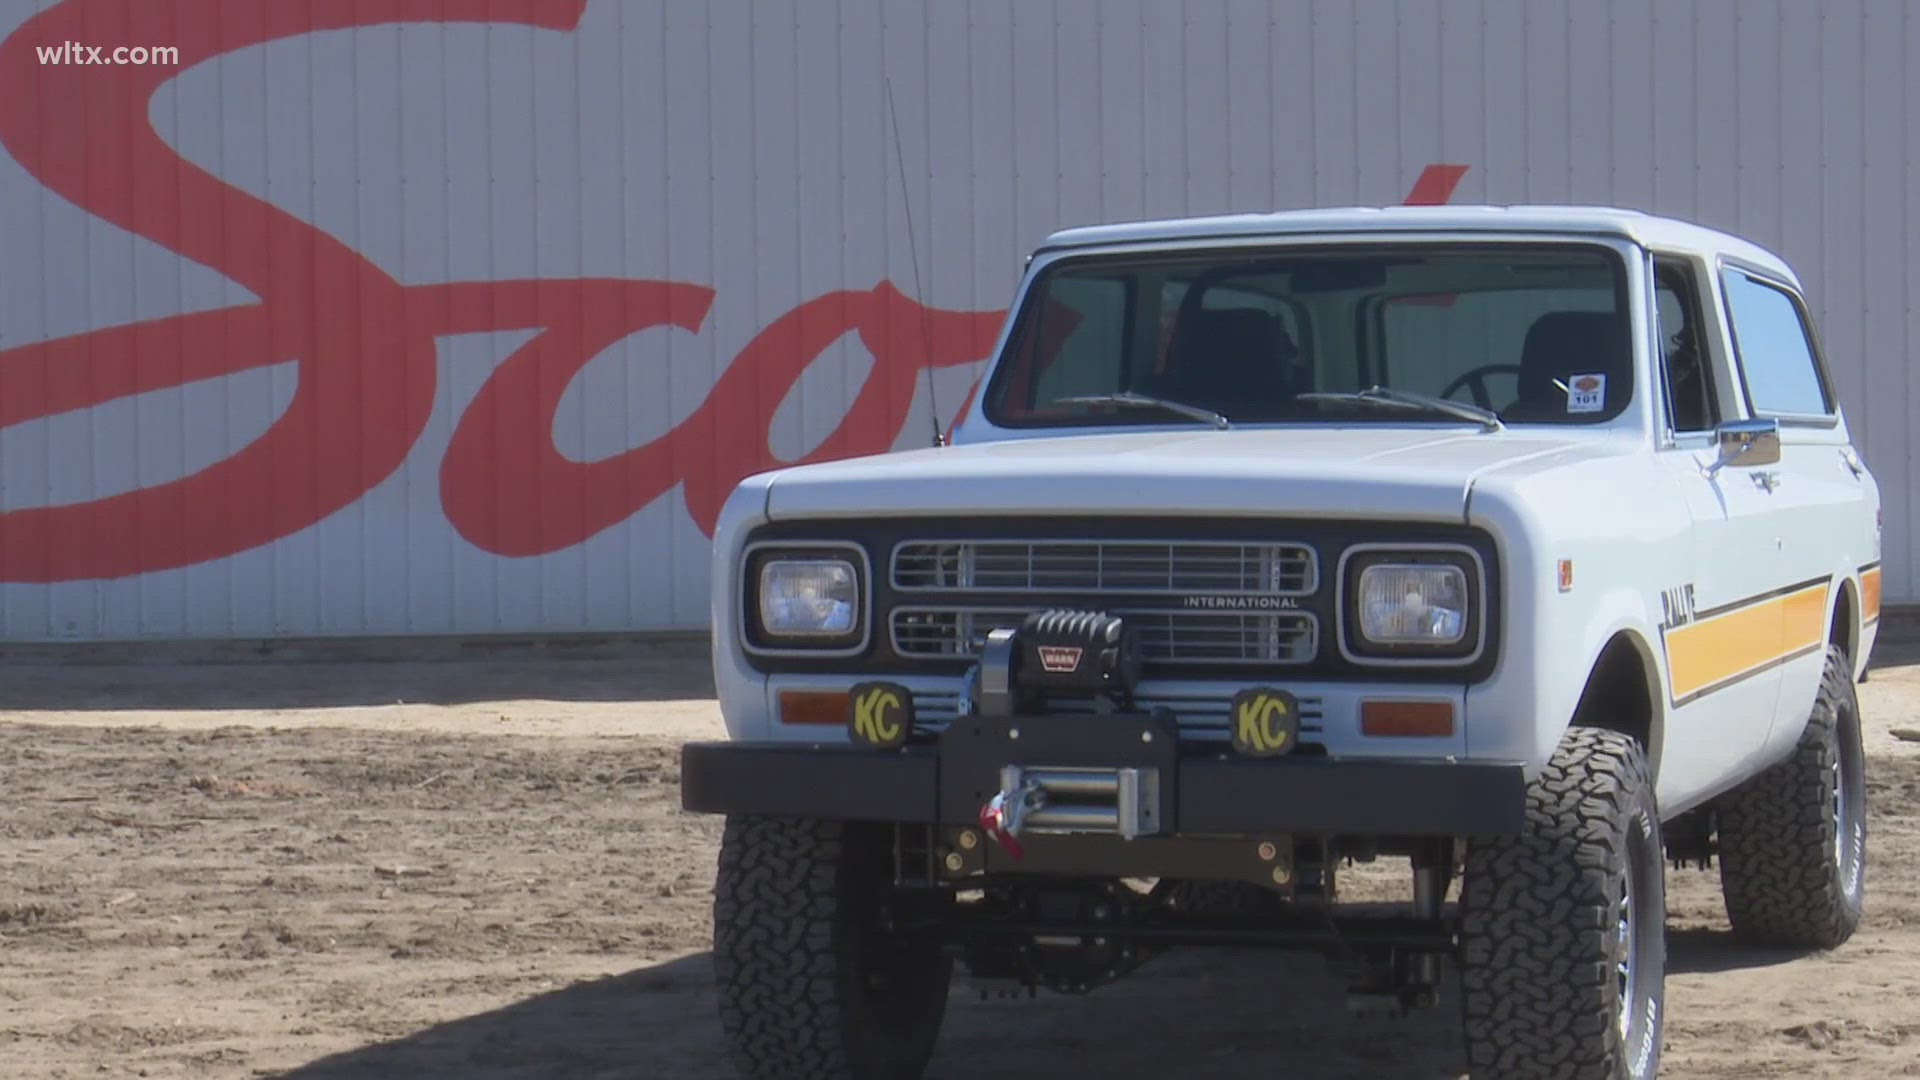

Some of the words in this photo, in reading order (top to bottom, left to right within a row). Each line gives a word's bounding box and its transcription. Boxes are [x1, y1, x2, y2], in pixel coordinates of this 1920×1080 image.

[1184, 596, 1298, 609] INTERNATIONAL
[1045, 654, 1075, 664] WARN
[855, 688, 900, 744] KC
[1239, 694, 1288, 752] KC
